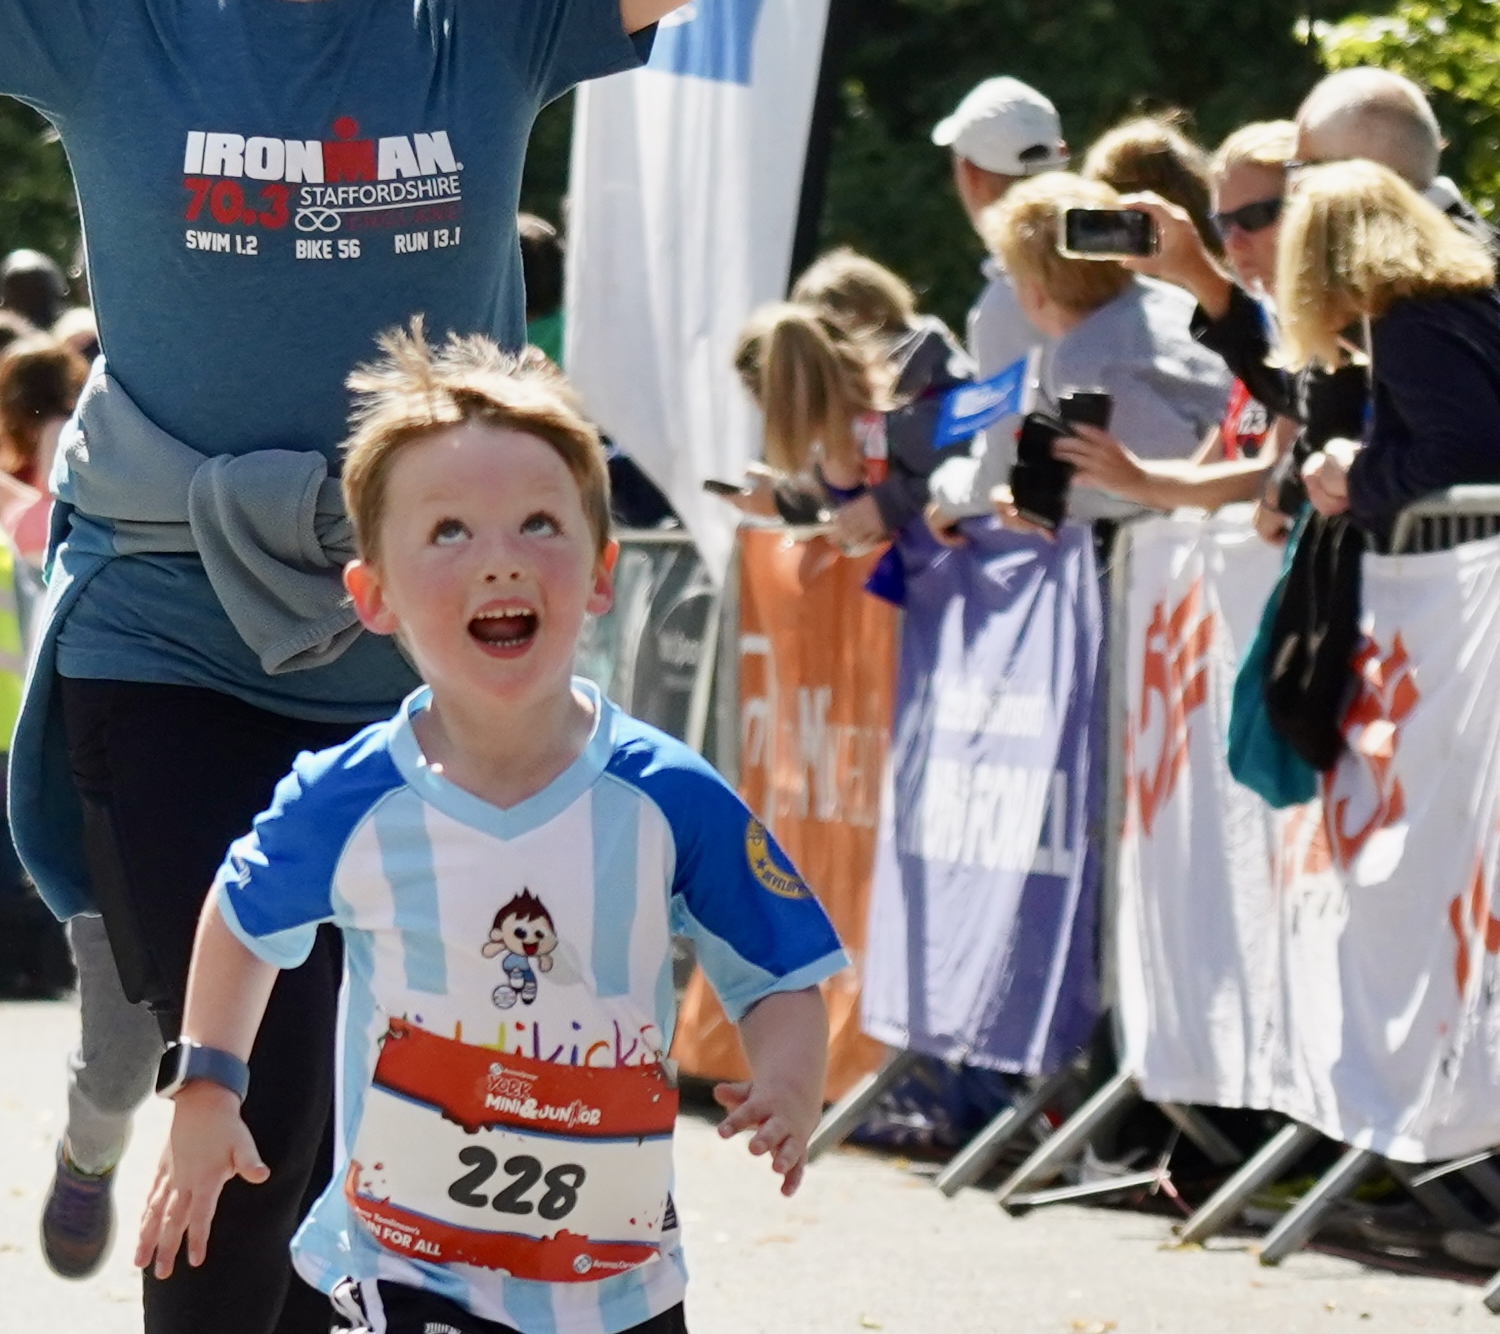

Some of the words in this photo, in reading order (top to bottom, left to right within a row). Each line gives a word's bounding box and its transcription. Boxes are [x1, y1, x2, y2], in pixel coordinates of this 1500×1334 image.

[183, 178, 291, 229] 70.3
[299, 175, 462, 207] STAFFORDSHIRE
[185, 229, 231, 253] SWIM
[235, 235, 259, 256] 1.2
[295, 238, 333, 260] BIKE
[337, 238, 361, 259] 56
[394, 231, 430, 255] RUN
[433, 227, 462, 250] 13.1
[487, 1074, 533, 1099] YORK
[447, 1145, 587, 1221] 228
[382, 1224, 414, 1250] FOR
[416, 1238, 443, 1257] ALL
